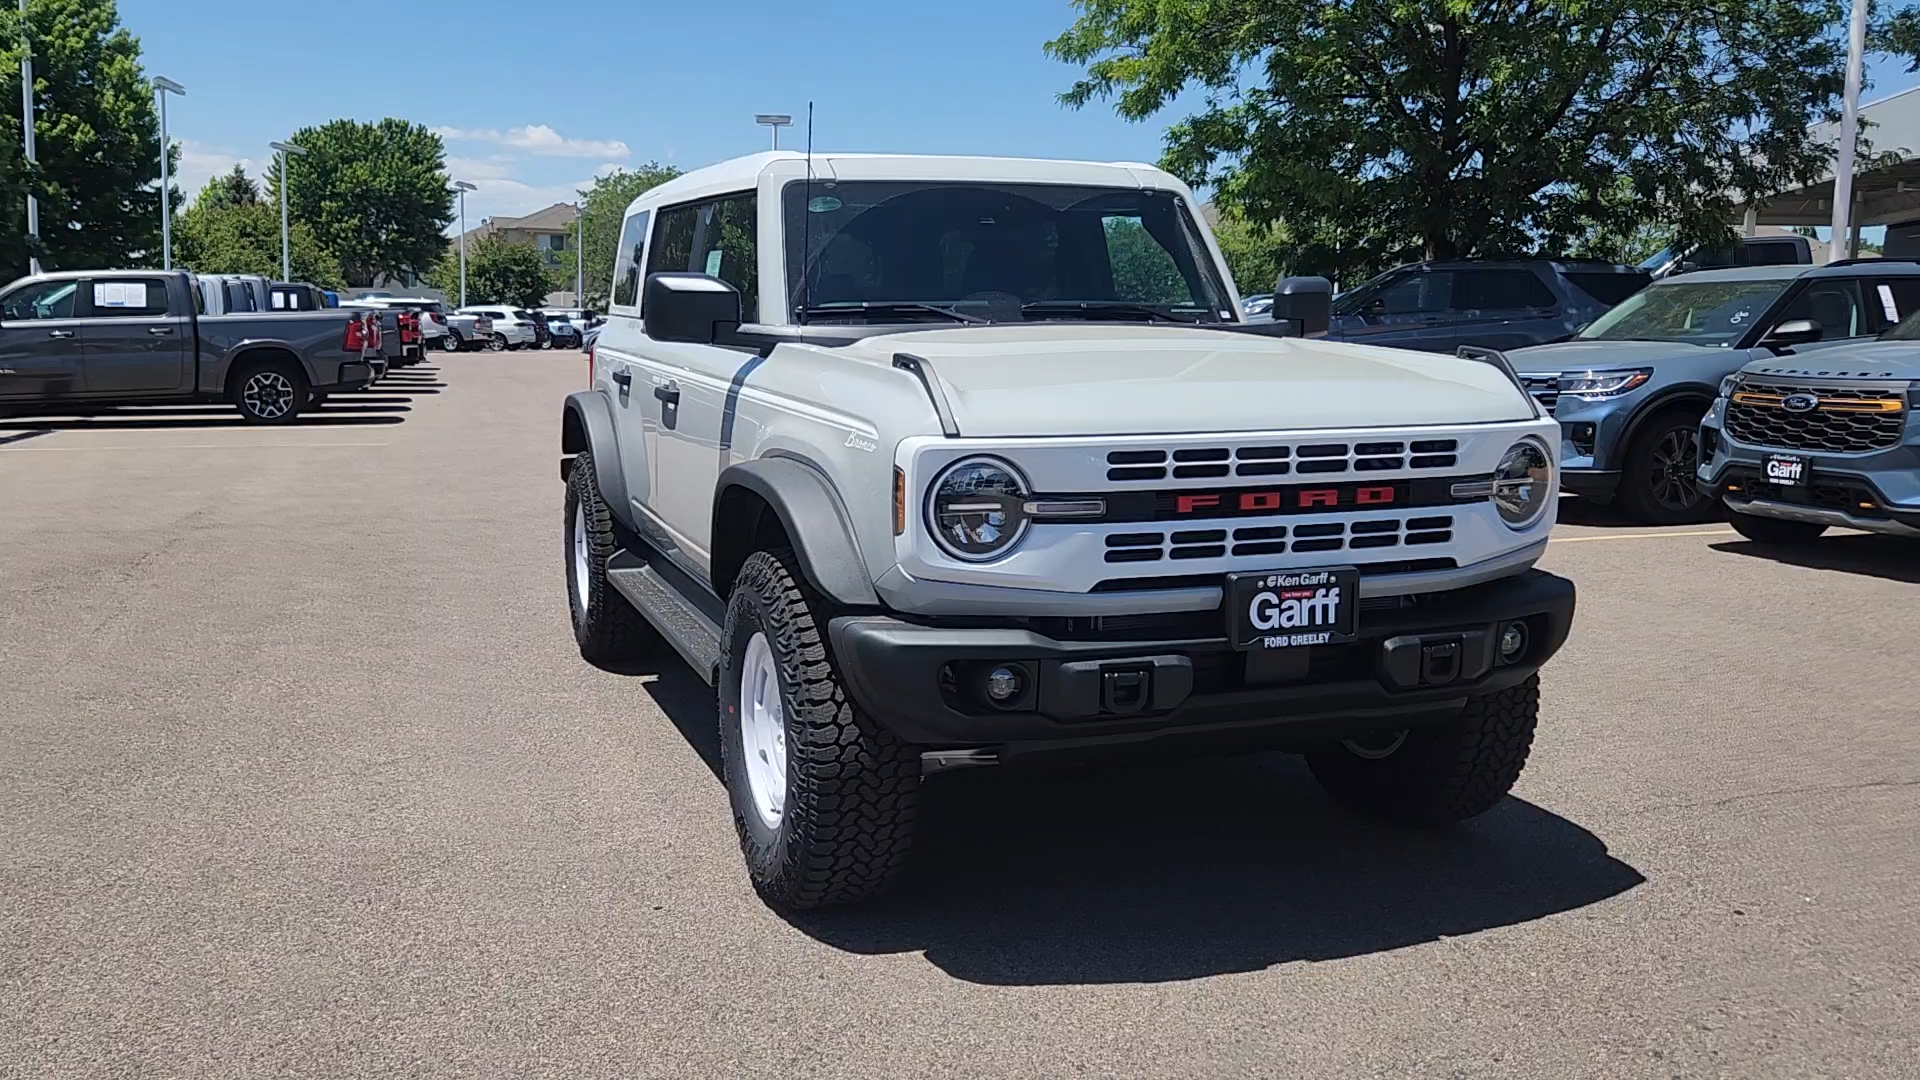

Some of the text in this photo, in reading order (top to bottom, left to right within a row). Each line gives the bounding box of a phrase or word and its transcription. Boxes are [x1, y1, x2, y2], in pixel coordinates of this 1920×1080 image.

[844, 429, 877, 452] Bronco
[1767, 460, 1802, 479] Garff
[1177, 487, 1394, 512] FORD
[1277, 572, 1328, 586] Ken Garff
[1249, 587, 1340, 630] Garff
[1264, 633, 1330, 648] FORD GREELEY
